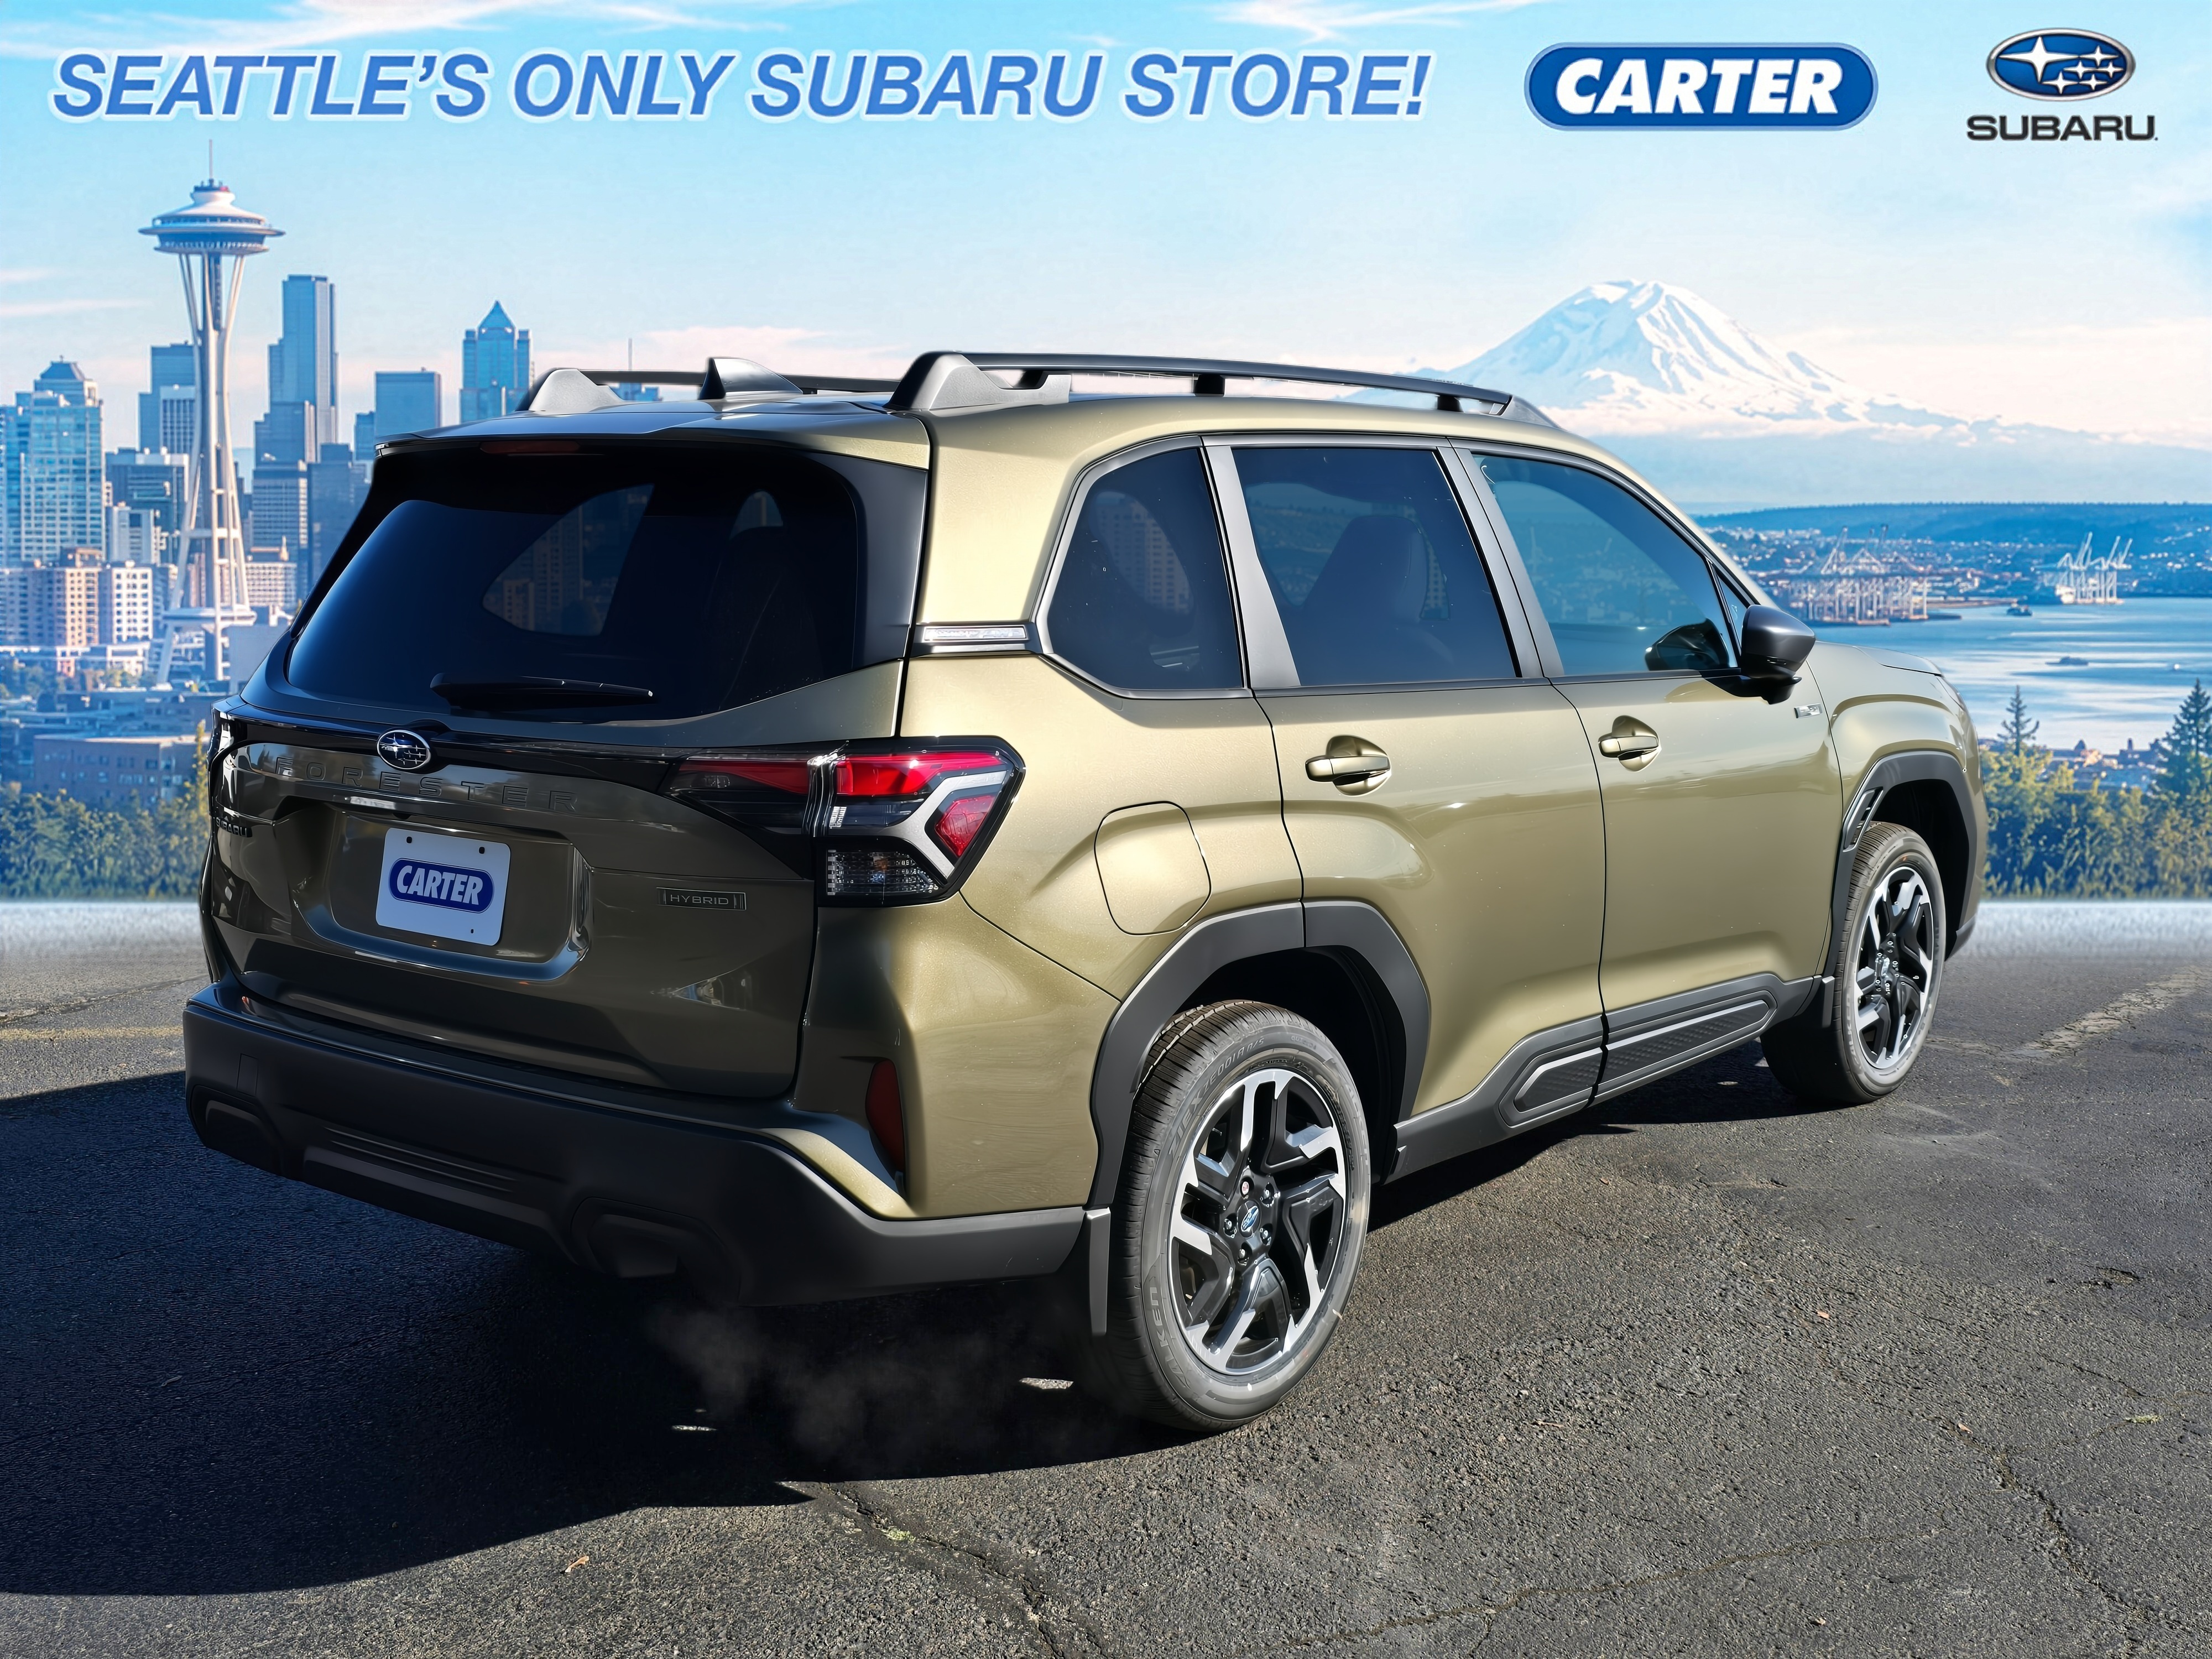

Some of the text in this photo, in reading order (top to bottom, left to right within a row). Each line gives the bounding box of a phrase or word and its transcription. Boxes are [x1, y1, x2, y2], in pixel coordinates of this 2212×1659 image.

[276, 757, 577, 812] FORESTER
[397, 865, 484, 906] CARTER
[670, 894, 729, 905] HYBRID
